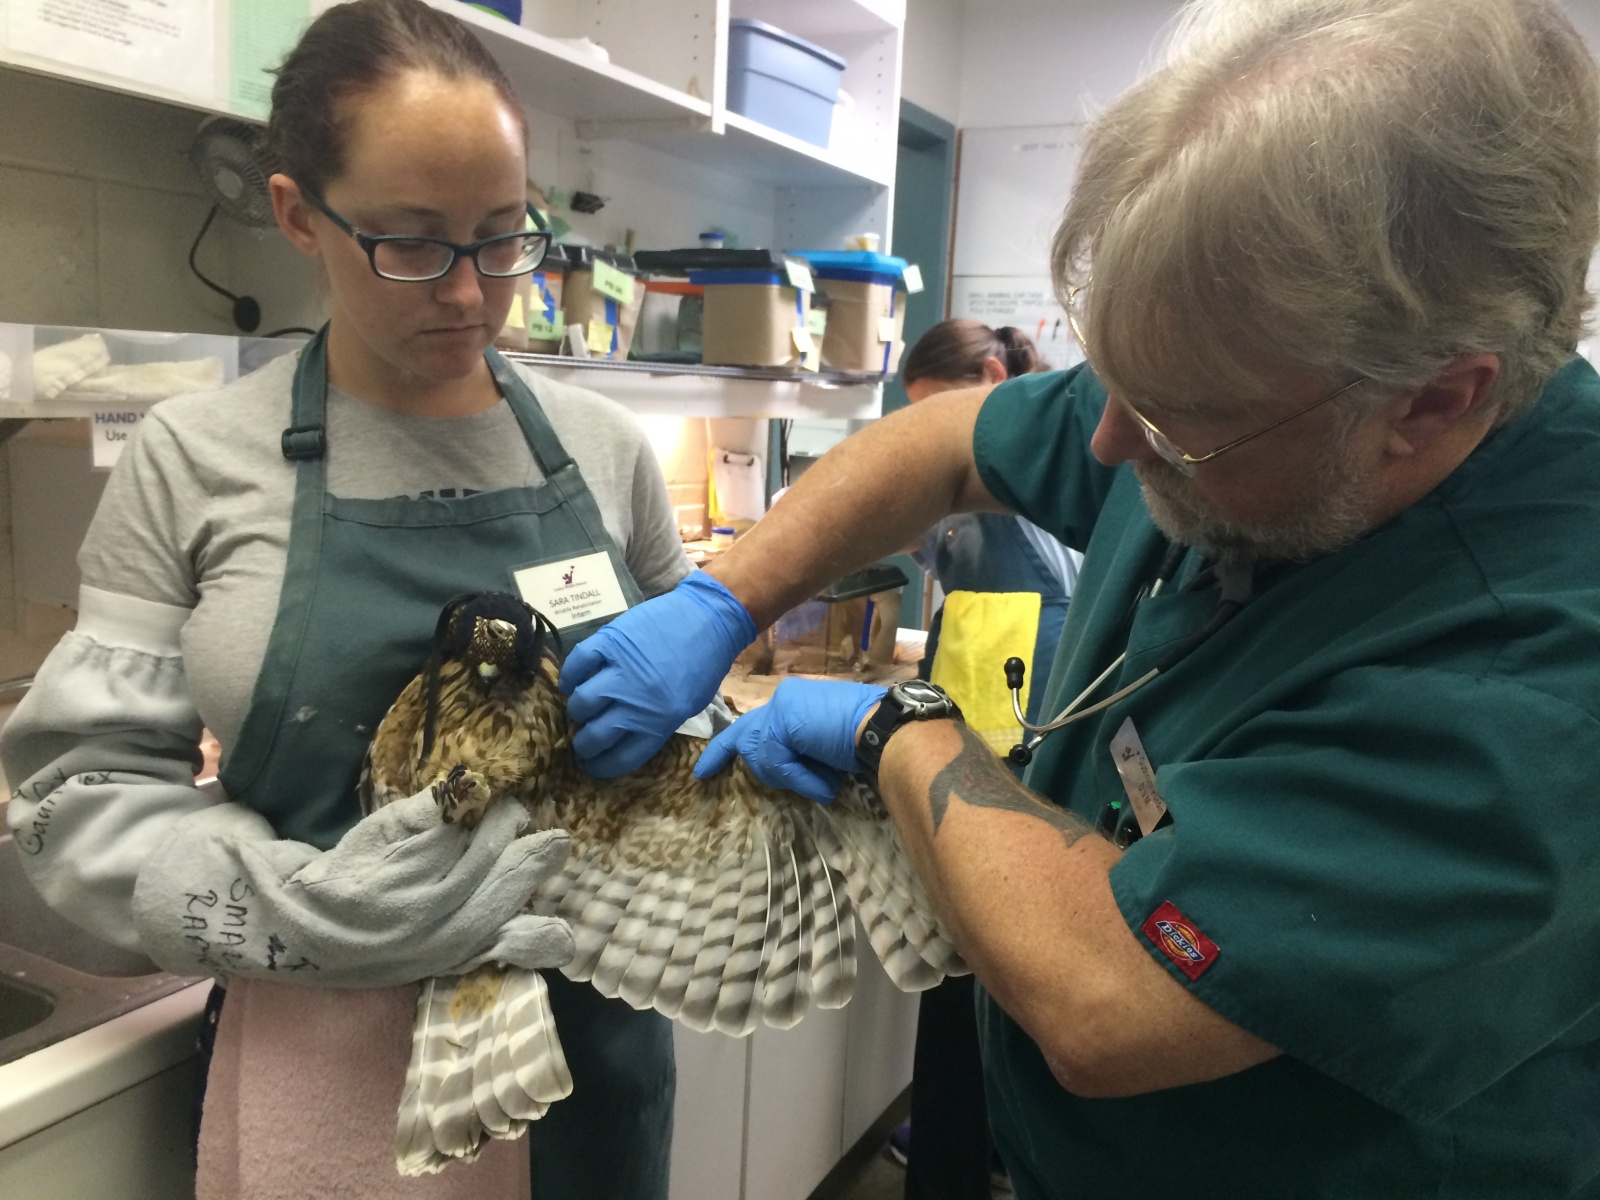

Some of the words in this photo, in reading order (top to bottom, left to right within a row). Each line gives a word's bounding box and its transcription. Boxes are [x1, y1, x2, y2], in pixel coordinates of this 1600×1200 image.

[95, 412, 137, 423] HAND
[106, 430, 127, 441] Use
[549, 597, 569, 608] SARA
[570, 589, 601, 601] TINDALL
[571, 610, 591, 619] Intern
[1161, 924, 1198, 958] Dickies
